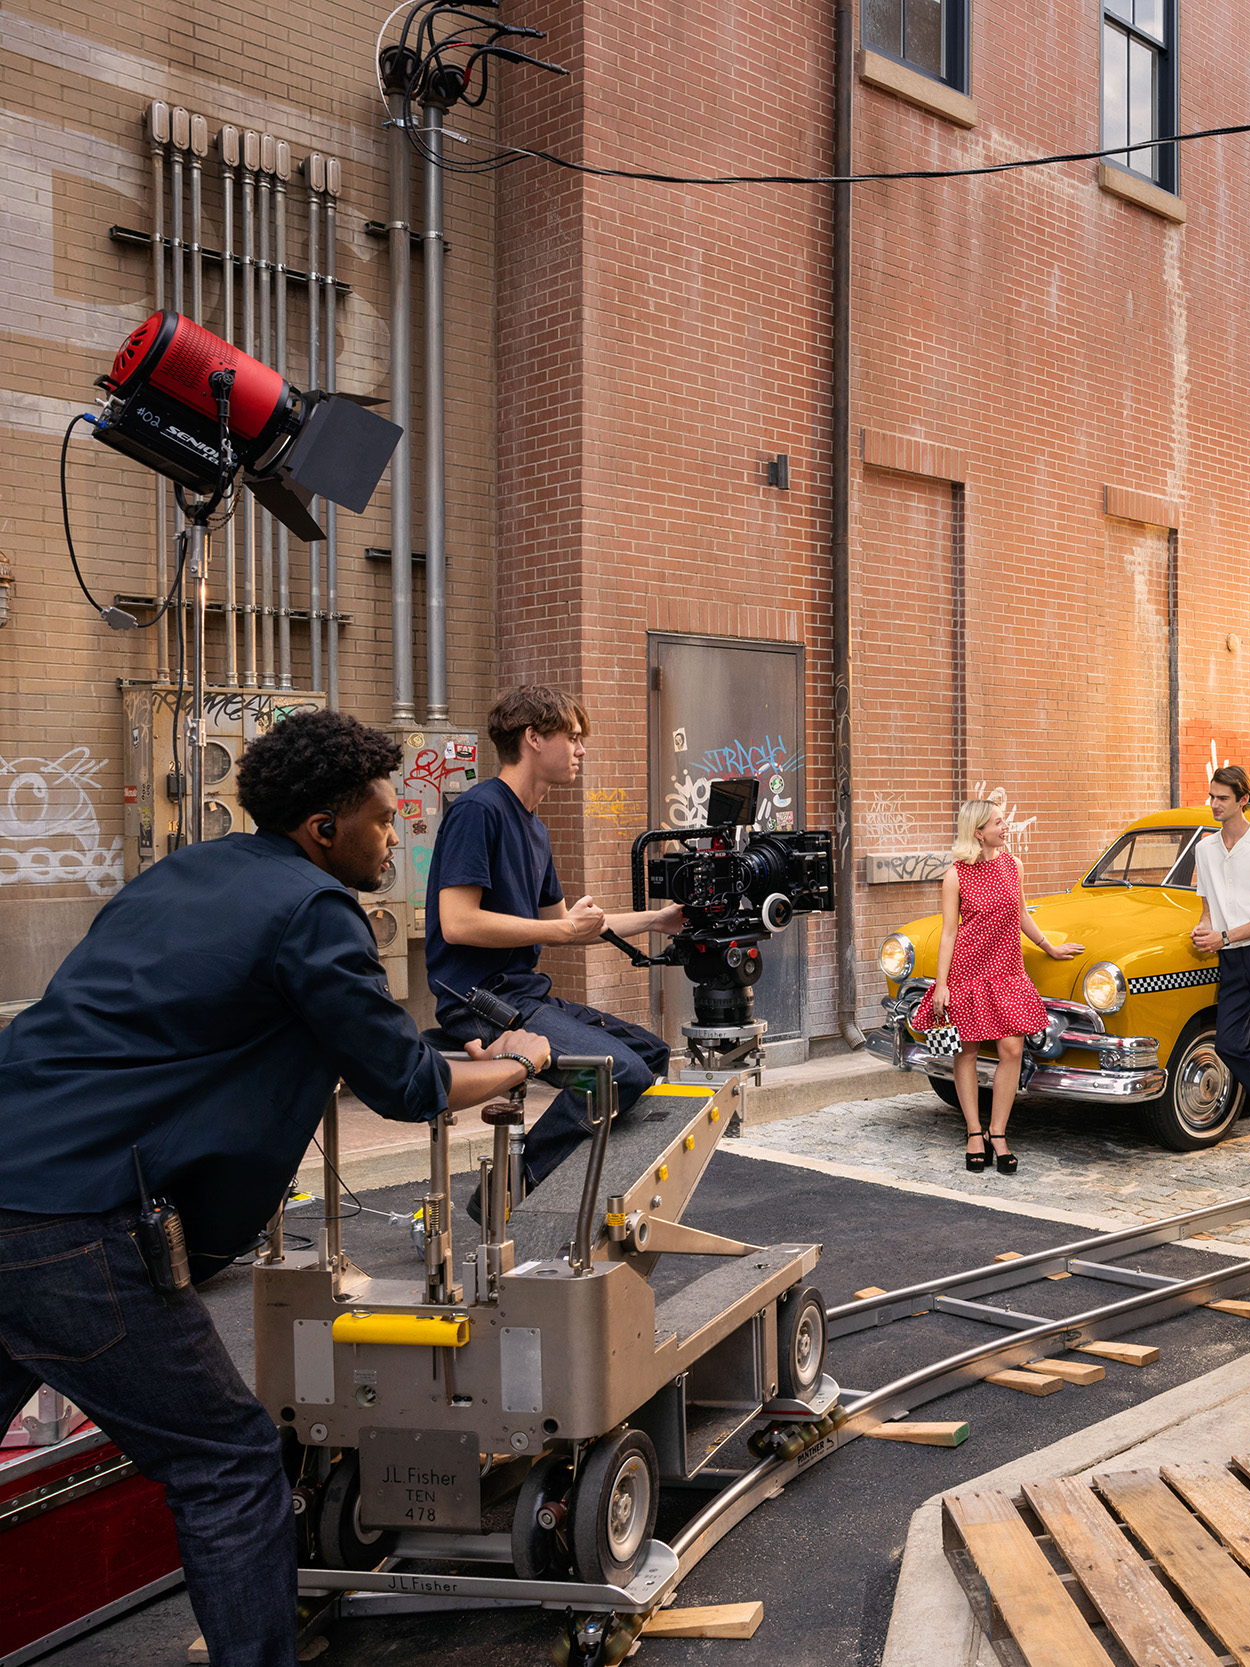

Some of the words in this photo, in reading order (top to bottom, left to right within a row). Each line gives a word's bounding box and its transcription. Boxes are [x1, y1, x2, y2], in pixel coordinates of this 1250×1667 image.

[136, 407, 161, 428] #02
[166, 425, 219, 458] SENIO
[797, 1440, 825, 1465] PANTHER
[406, 1488, 435, 1503] TEN
[405, 1507, 436, 1522] 478
